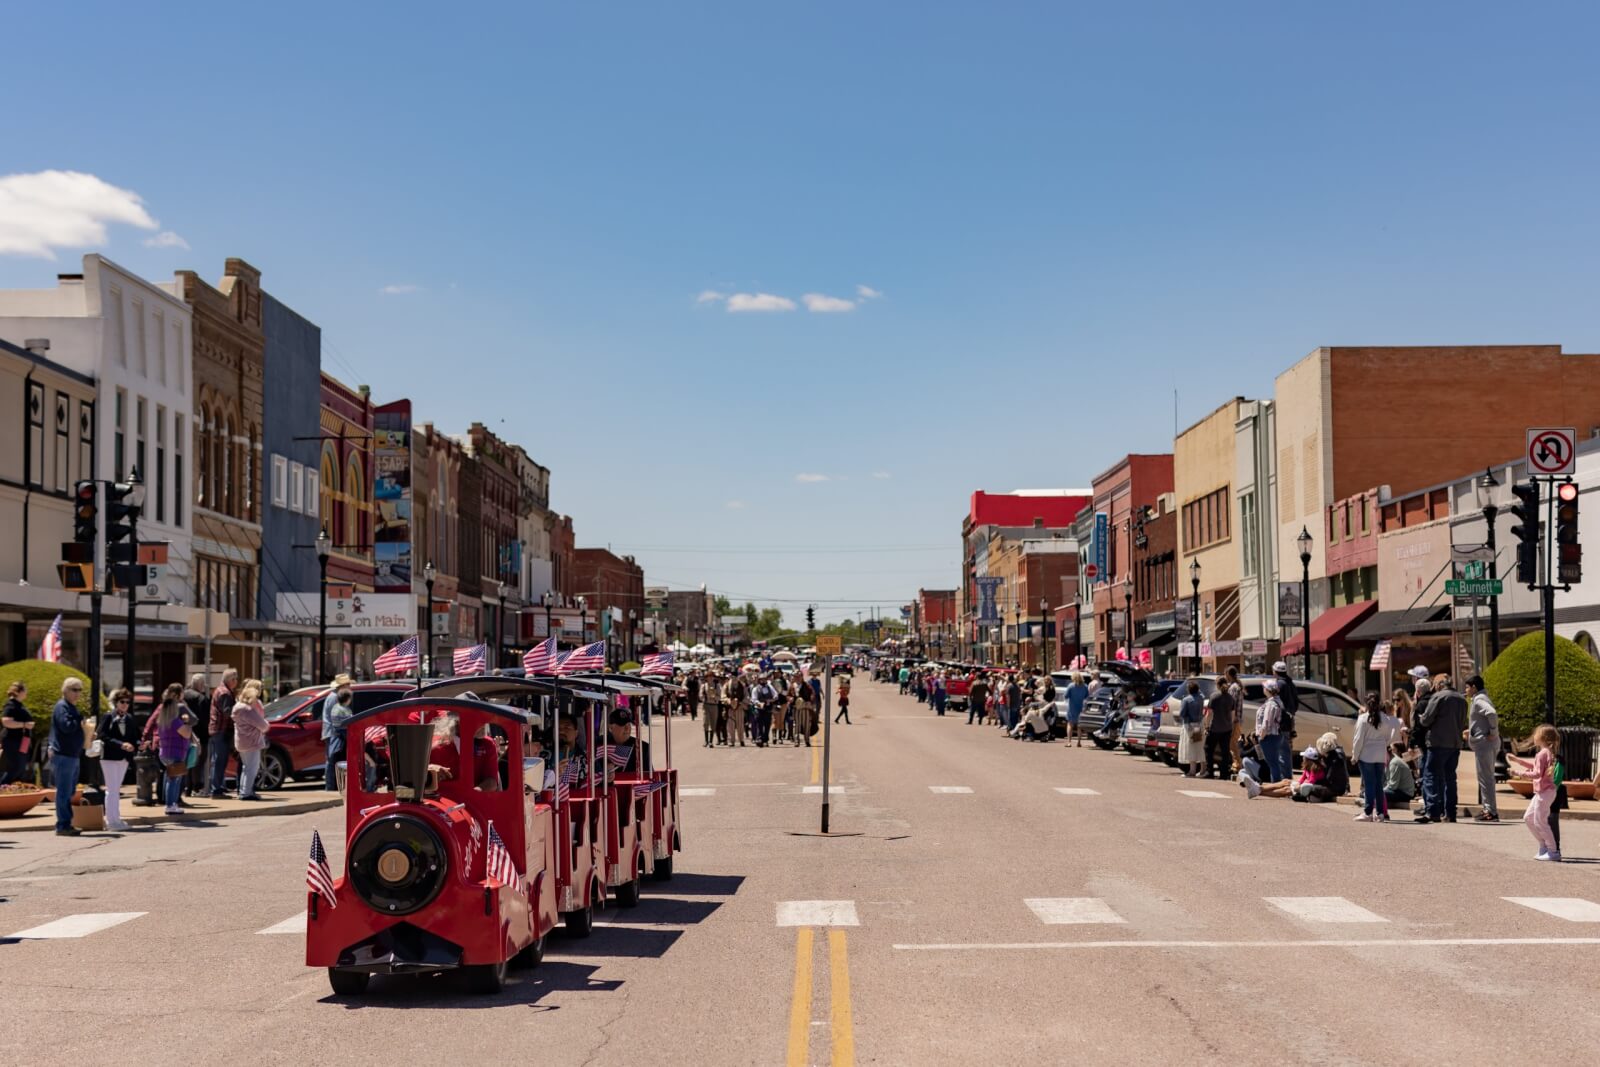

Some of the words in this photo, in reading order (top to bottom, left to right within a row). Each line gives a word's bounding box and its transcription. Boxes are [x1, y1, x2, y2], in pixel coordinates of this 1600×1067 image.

[149, 567, 157, 579] 5
[1459, 581, 1493, 594] Burnett
[337, 600, 344, 609] 5
[354, 616, 372, 627] on
[375, 614, 407, 627] Main
